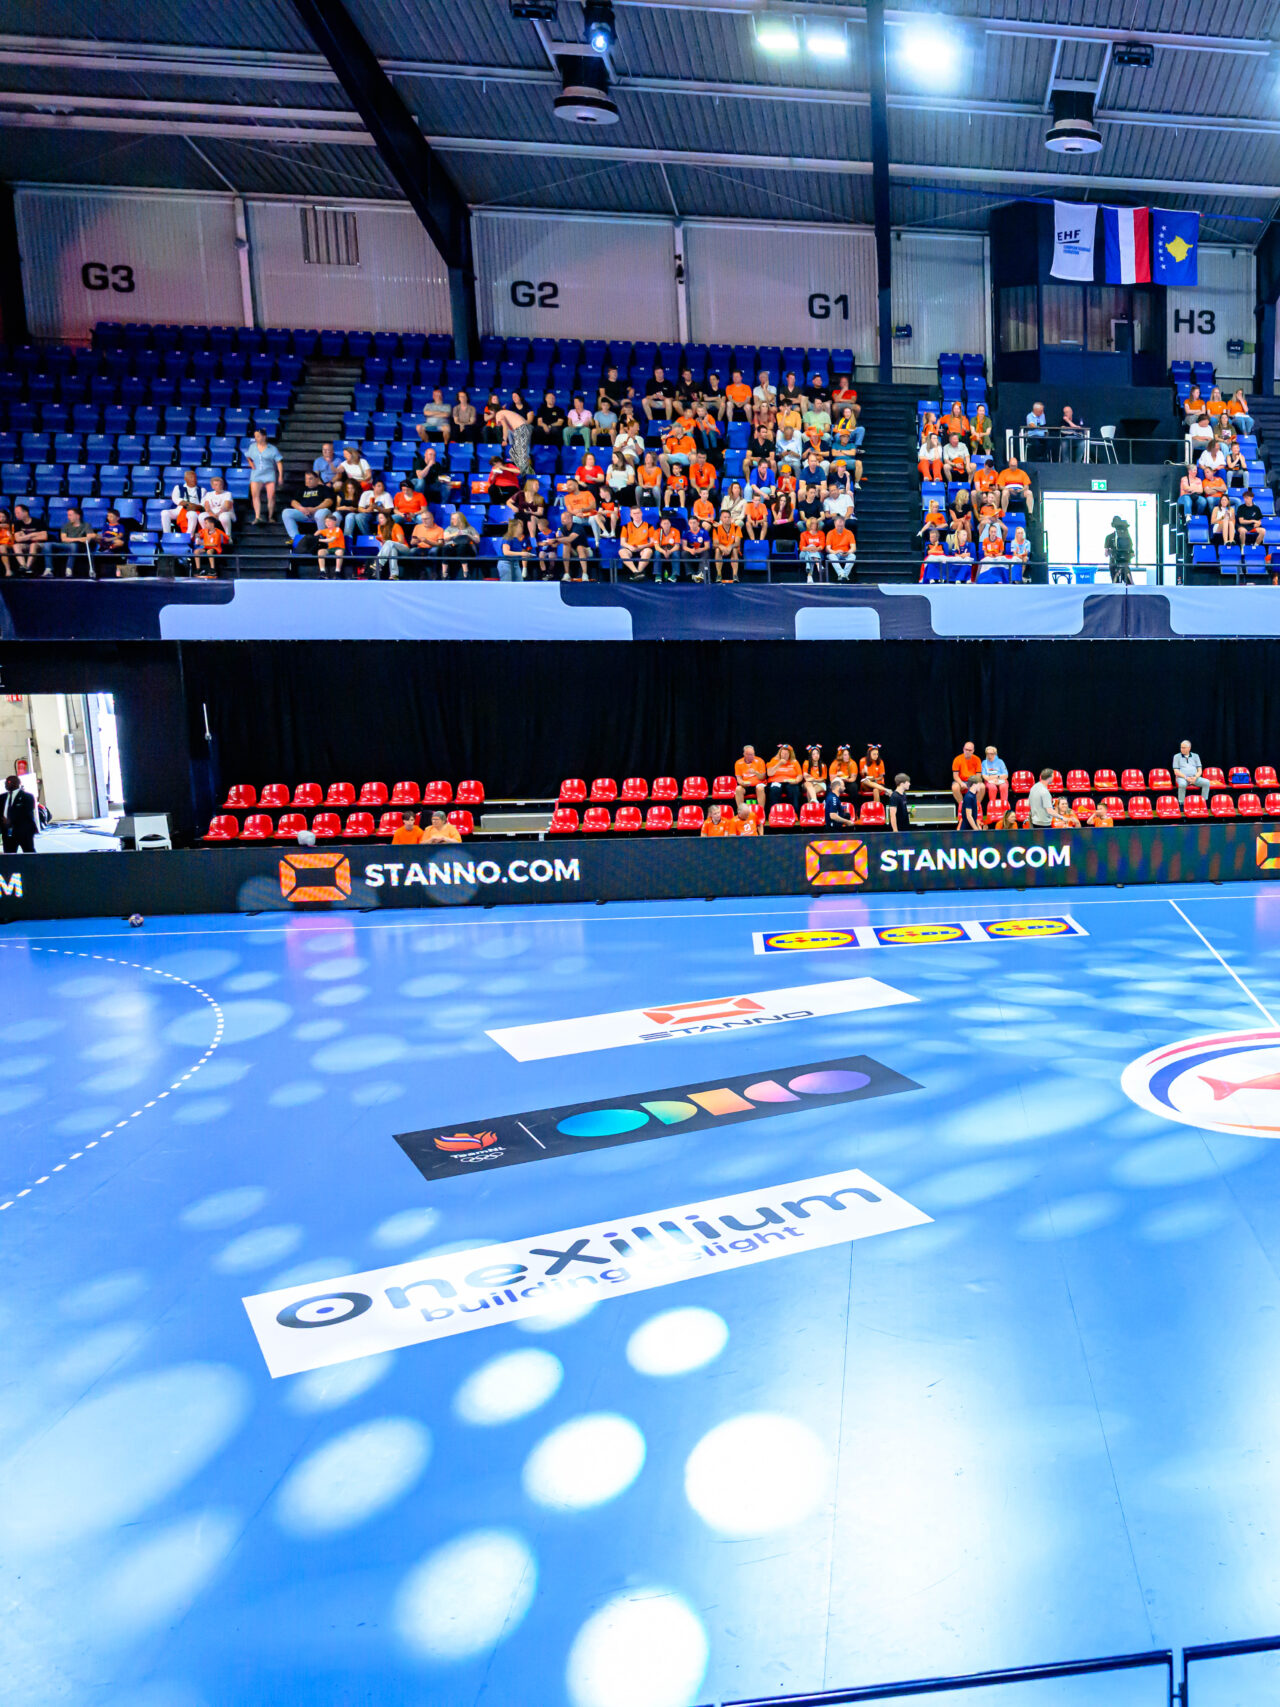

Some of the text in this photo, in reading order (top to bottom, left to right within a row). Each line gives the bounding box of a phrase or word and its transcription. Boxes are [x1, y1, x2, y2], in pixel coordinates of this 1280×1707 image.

[1057, 230, 1081, 241] EHF
[80, 260, 136, 294] G3
[510, 280, 560, 308] G2
[807, 293, 850, 320] G1
[1174, 308, 1216, 335] H3
[880, 844, 1071, 872] STANNO.COM
[364, 858, 580, 888] STANNO.COM
[638, 1010, 814, 1041] STANNO
[450, 1146, 507, 1160] TeamNL
[420, 1266, 631, 1322] building
